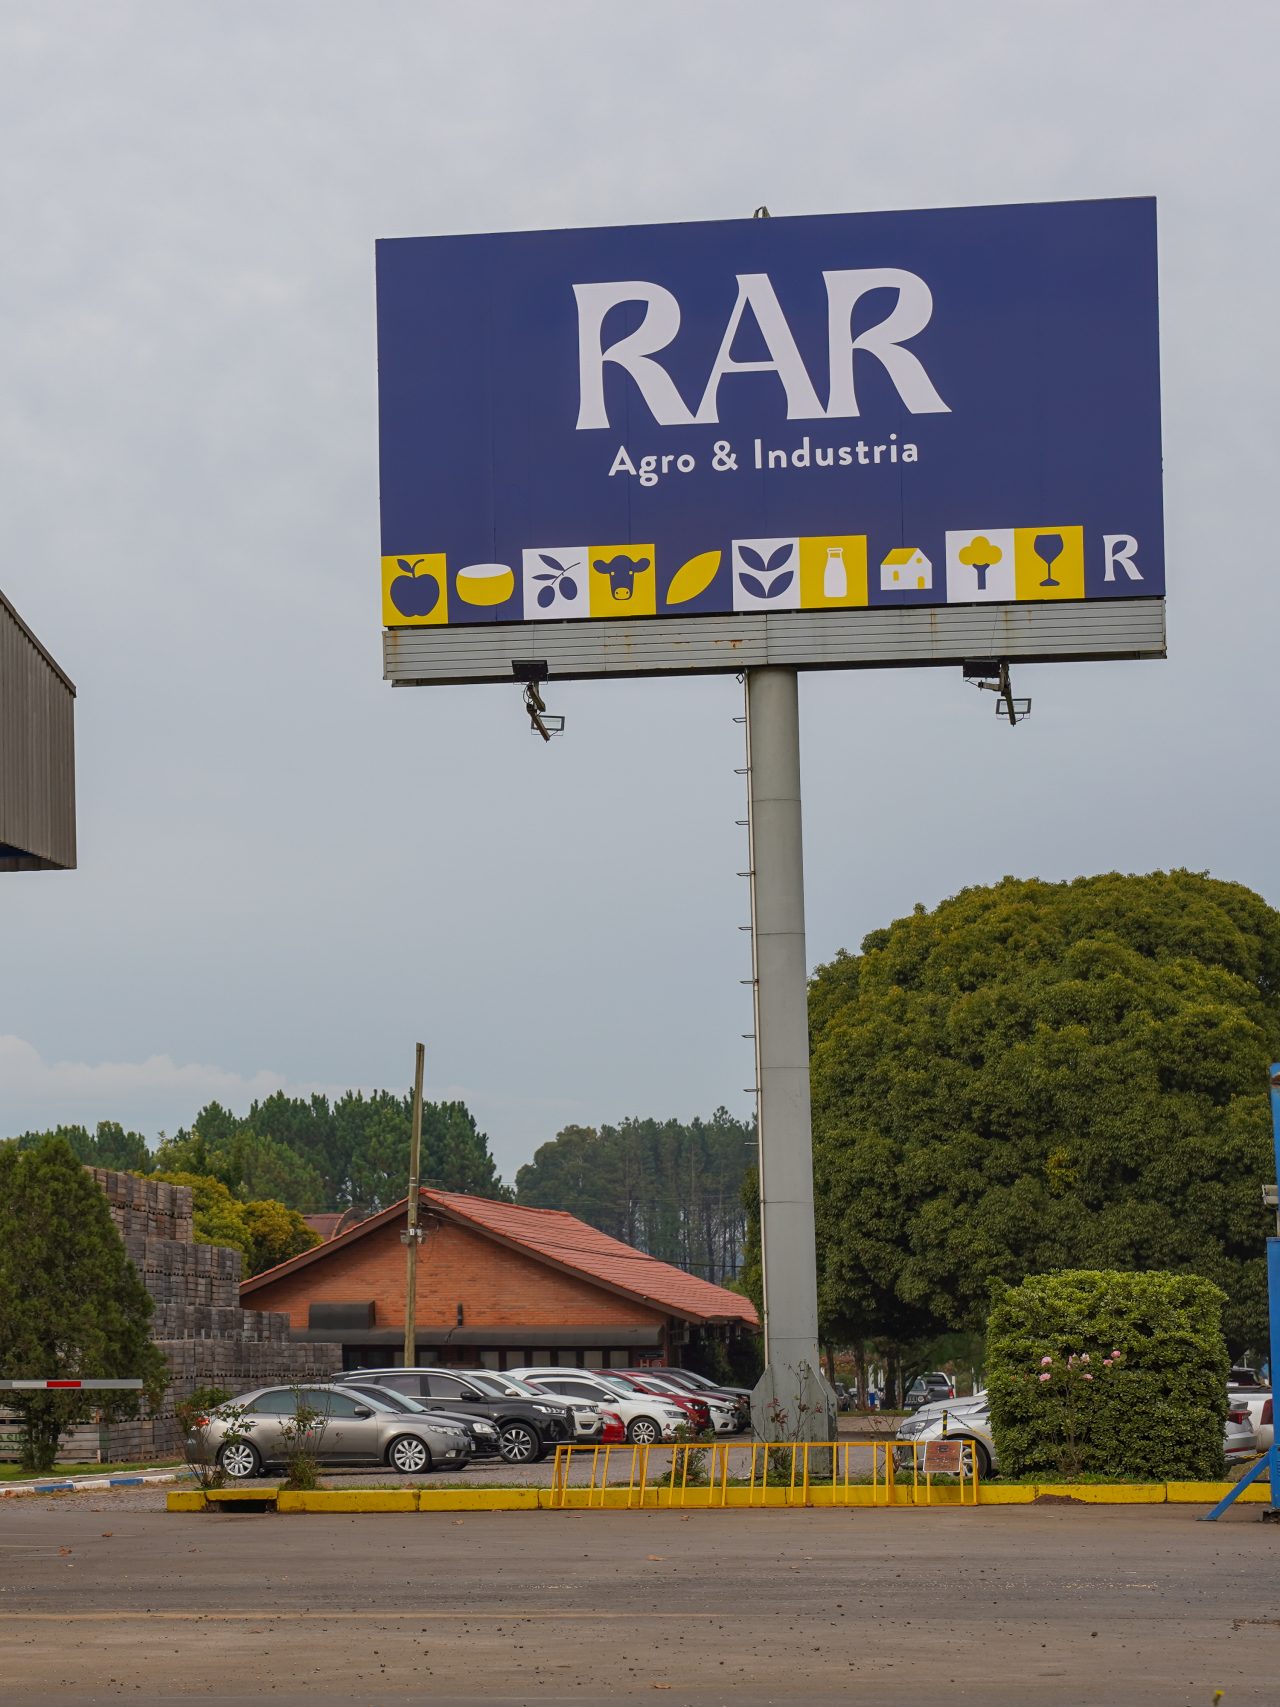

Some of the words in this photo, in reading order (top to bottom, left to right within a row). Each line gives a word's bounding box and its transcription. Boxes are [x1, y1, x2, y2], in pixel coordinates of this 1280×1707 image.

[572, 267, 953, 430] RAR
[608, 444, 696, 486] Agro
[711, 439, 738, 470] &
[754, 433, 920, 470] Industria
[1103, 534, 1145, 582] R
